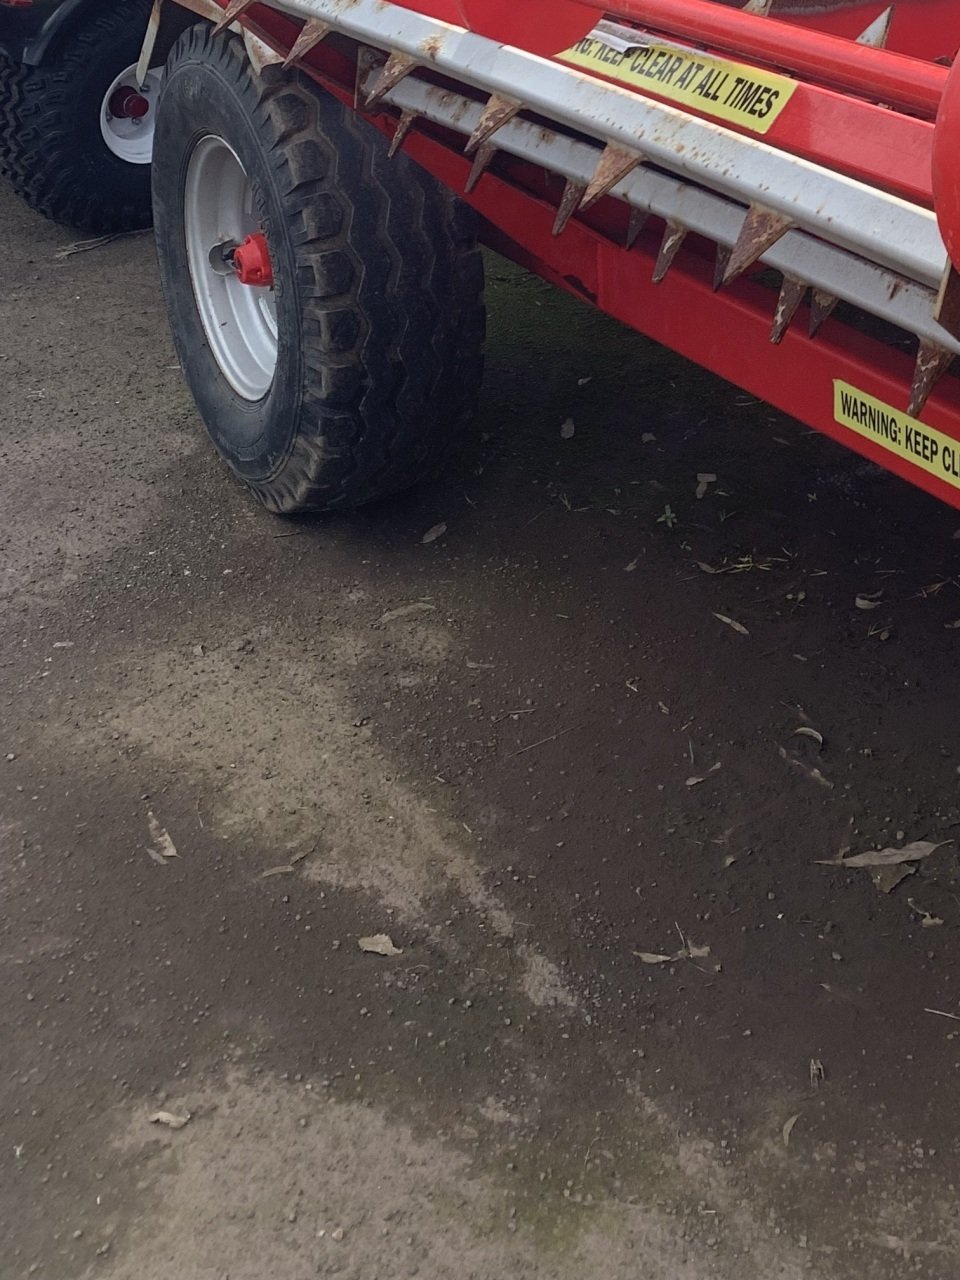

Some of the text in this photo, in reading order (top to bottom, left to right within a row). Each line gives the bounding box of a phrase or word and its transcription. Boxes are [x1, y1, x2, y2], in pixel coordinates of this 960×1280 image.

[630, 48, 682, 84] CLEAR
[674, 62, 705, 91] AT
[692, 68, 730, 102] ALL
[723, 77, 780, 118] TIMES
[840, 390, 902, 446] WARNING:
[905, 425, 939, 464] KEEP
